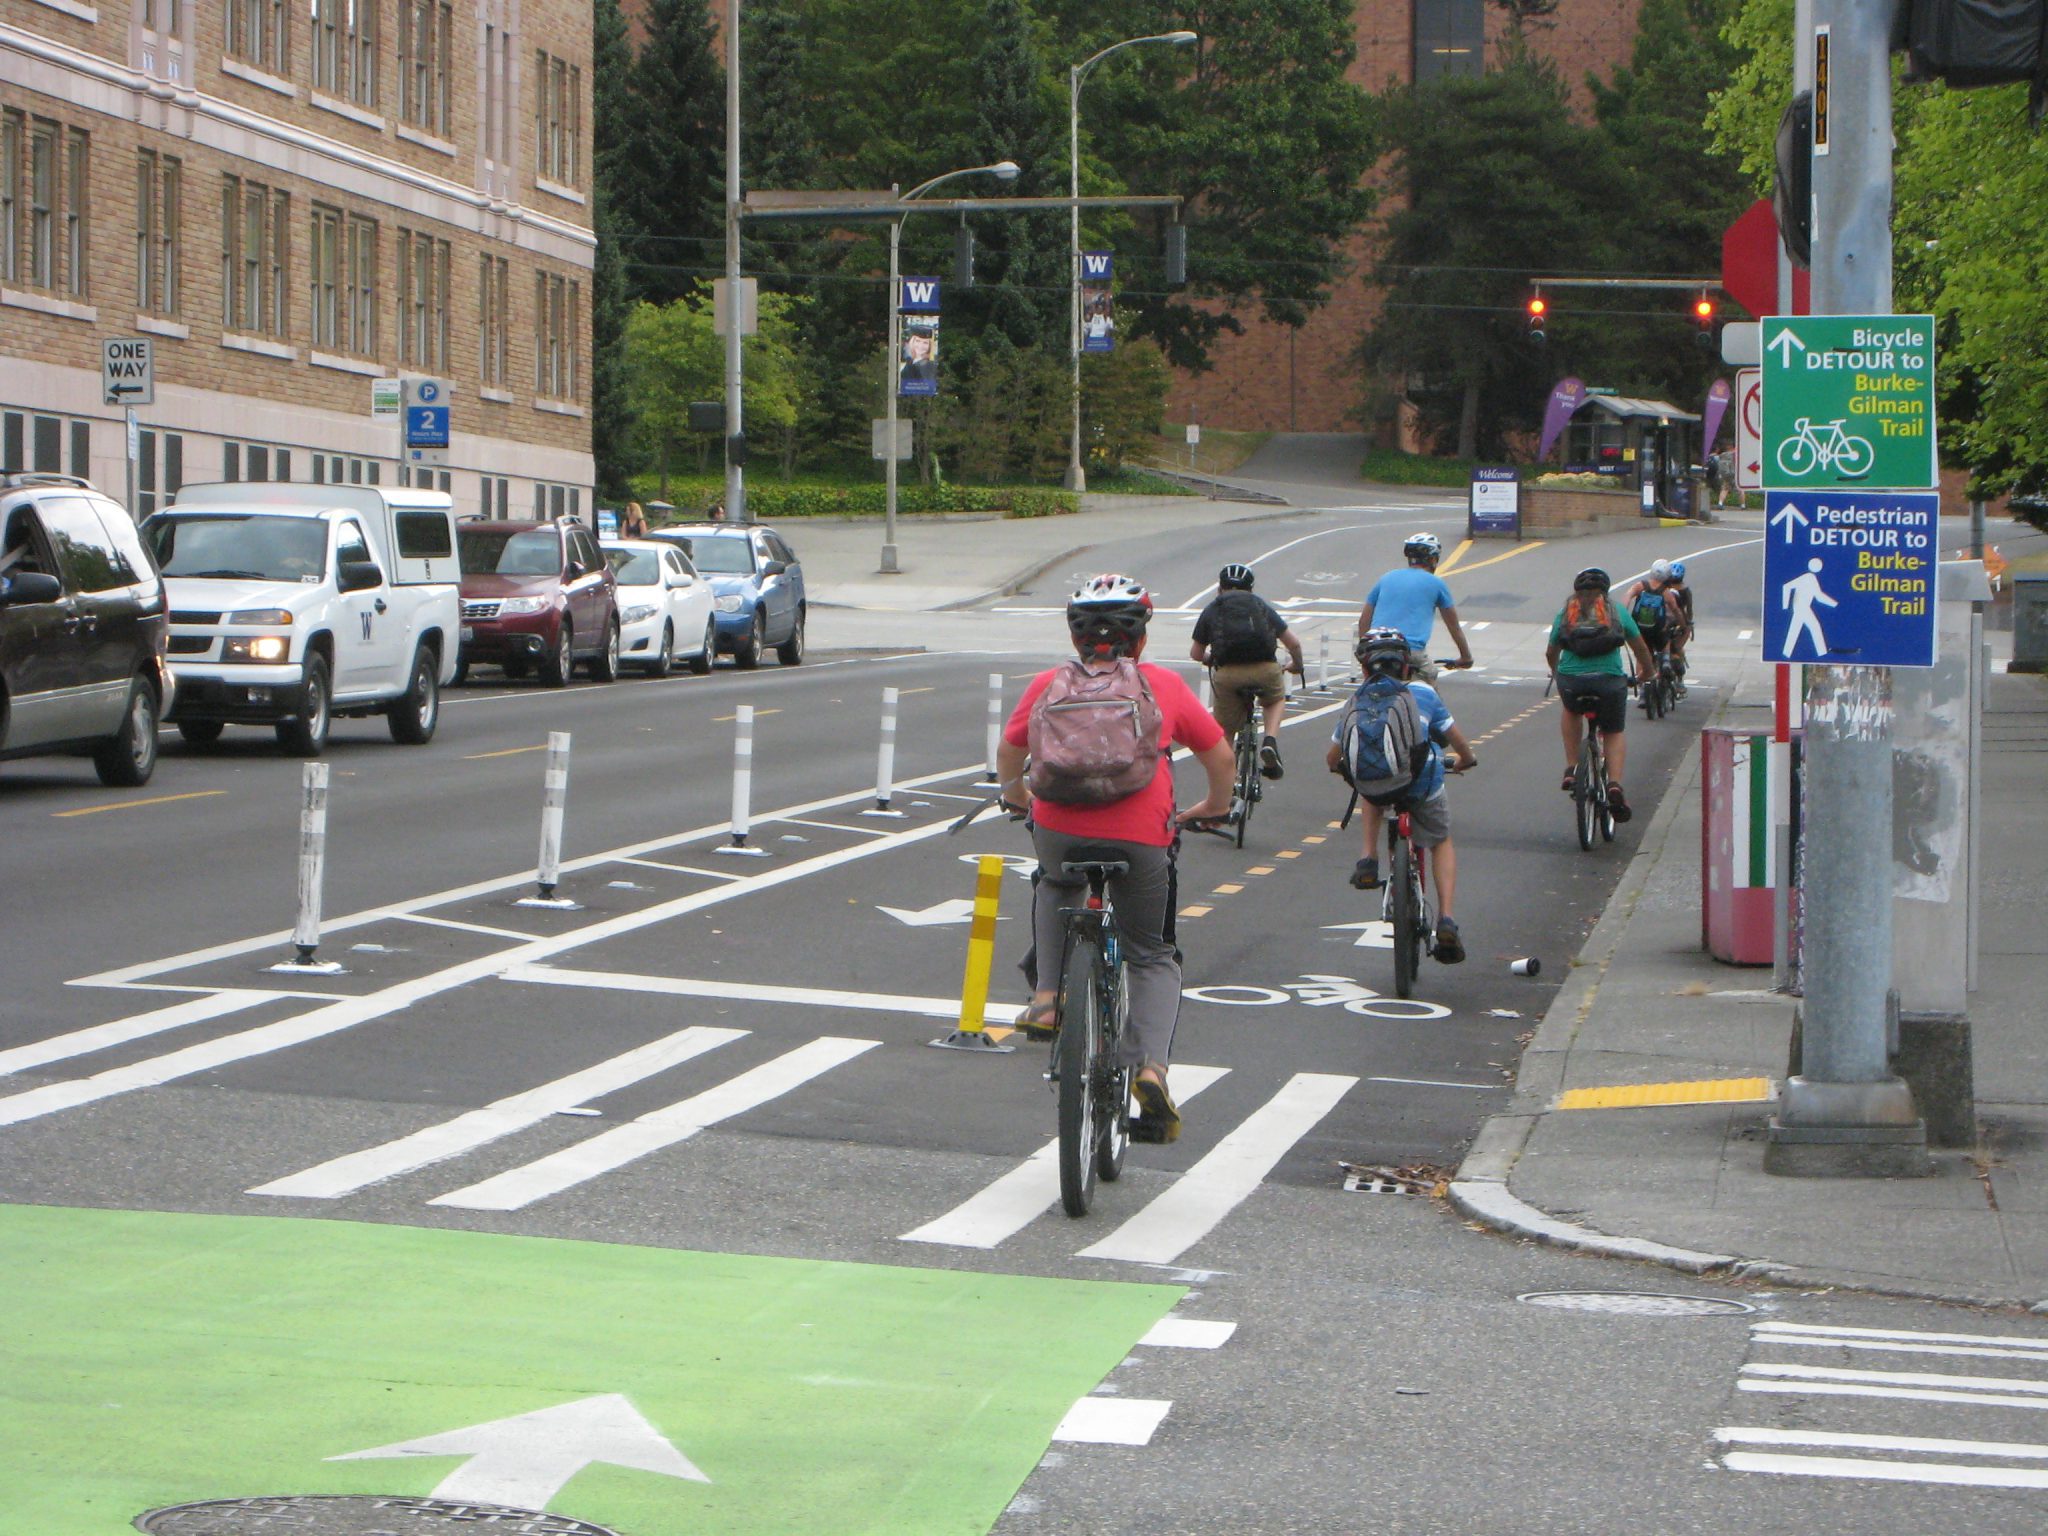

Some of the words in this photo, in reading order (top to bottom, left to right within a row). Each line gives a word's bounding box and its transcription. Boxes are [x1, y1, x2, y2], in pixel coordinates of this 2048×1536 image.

[1816, 34, 1827, 144] 1401
[1085, 255, 1109, 273] W
[906, 282, 936, 303] W
[1853, 328, 1924, 351] Bicycle
[108, 343, 145, 359] ONE
[108, 362, 147, 377] WAY
[1806, 352, 1895, 370] DETOUR
[1901, 353, 1924, 369] to
[423, 385, 435, 399] P
[1855, 373, 1924, 392] Burke-
[1849, 396, 1924, 414] Gilman
[421, 411, 435, 429] 2
[1878, 418, 1924, 437] Trail
[1479, 468, 1514, 479] Welcome
[1817, 505, 1928, 526] Pedestrian
[1810, 528, 1898, 547] DETOUR
[1905, 531, 1928, 548] to
[1858, 551, 1927, 570] Burke-
[1851, 574, 1925, 593] Gilman
[1880, 597, 1925, 615] Trail
[361, 611, 373, 641] W
